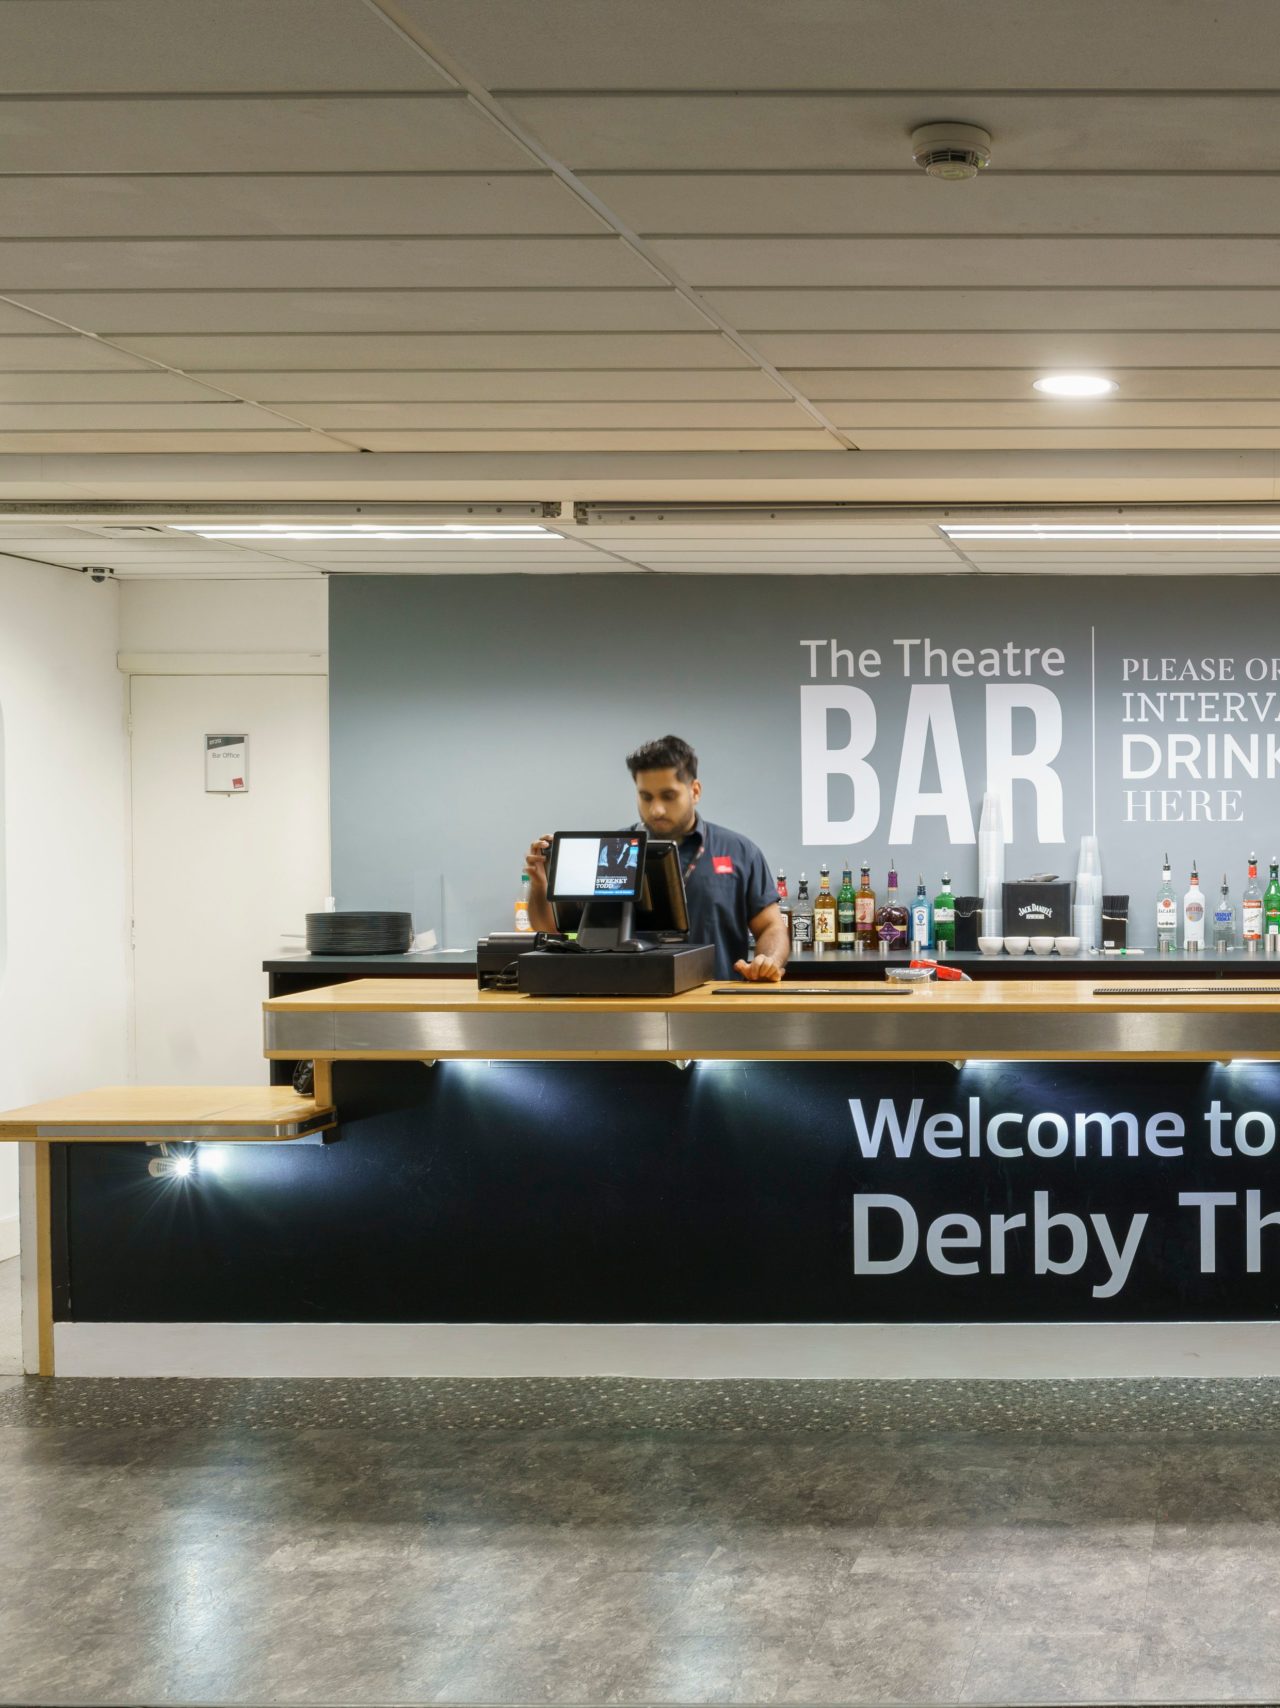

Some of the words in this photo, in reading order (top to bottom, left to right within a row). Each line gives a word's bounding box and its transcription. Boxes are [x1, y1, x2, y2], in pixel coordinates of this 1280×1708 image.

[800, 639, 881, 678] The
[893, 638, 1065, 677] Theatre
[1121, 658, 1235, 682] PLEASE
[800, 683, 1066, 846] BAR
[1121, 789, 1245, 823] HERE
[1018, 905, 1031, 917] JACK
[848, 1096, 1185, 1159] Welcome
[1204, 1100, 1276, 1157] to
[853, 1190, 1149, 1299] Derby
